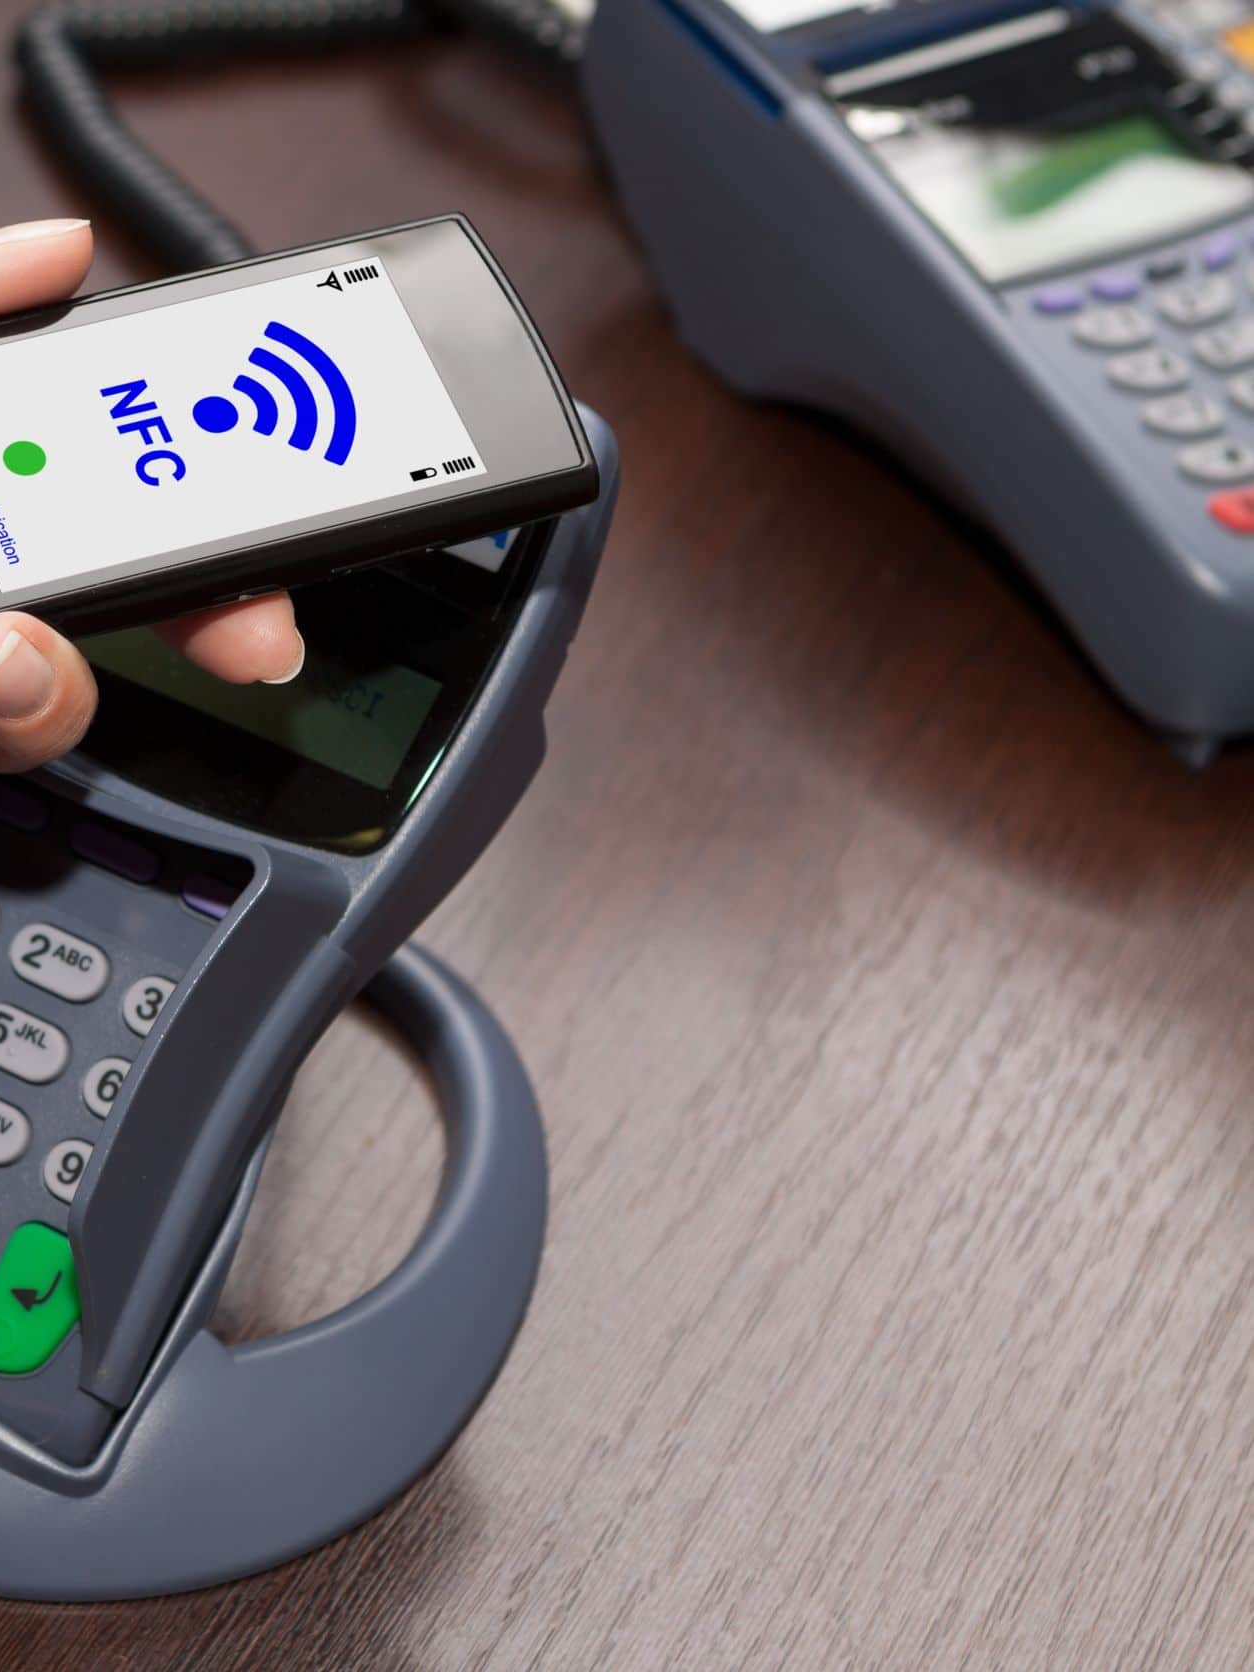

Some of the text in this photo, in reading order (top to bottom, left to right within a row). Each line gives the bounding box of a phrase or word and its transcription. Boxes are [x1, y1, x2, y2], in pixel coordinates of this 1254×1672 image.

[99, 379, 187, 488] NFC
[20, 933, 94, 973] 2 ABC
[136, 987, 164, 1021] 3
[15, 1023, 48, 1049] JKL
[97, 1069, 125, 1102] 6
[56, 1151, 85, 1185] 9
